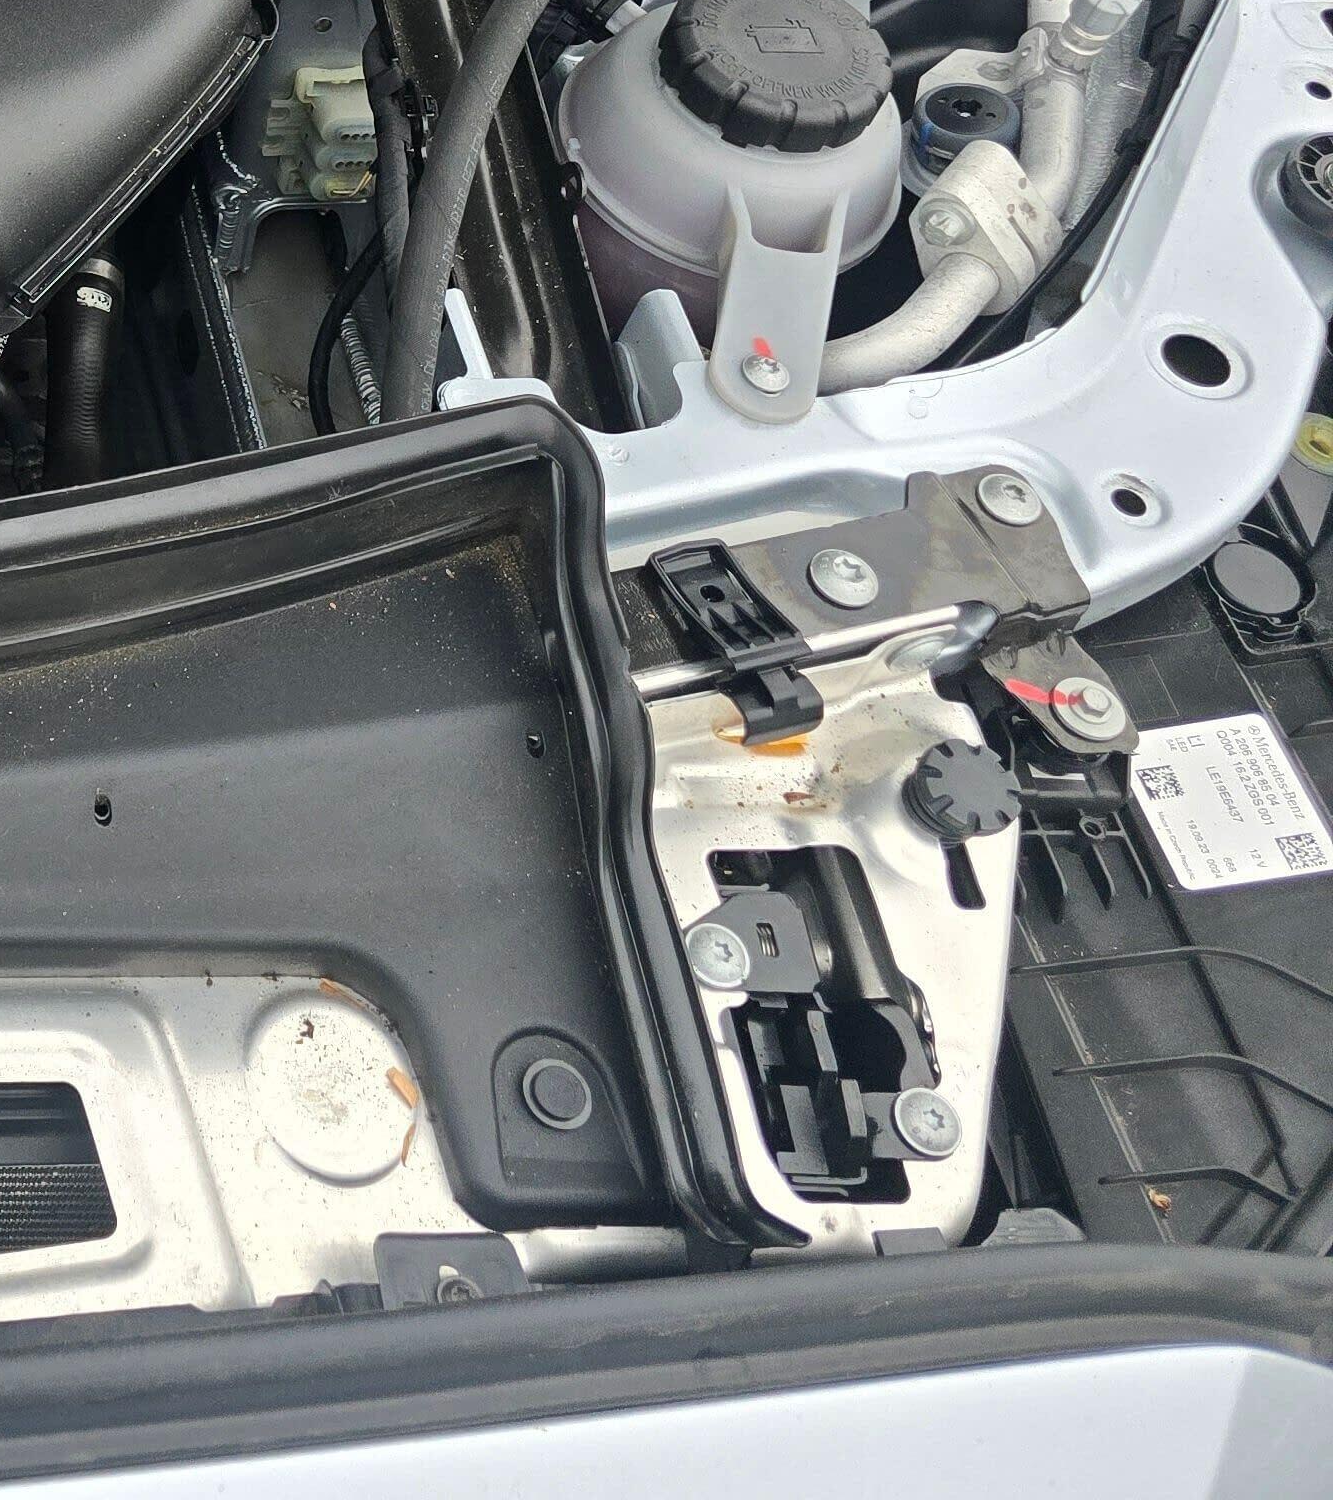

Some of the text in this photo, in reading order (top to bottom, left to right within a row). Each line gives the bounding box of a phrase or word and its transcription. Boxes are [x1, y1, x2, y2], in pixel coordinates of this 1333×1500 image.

[1175, 736, 1189, 753] LED
[1216, 730, 1237, 756] Q004
[1257, 807, 1275, 826] 001
[1229, 728, 1281, 806] A 206 906 85 04
[1252, 737, 1306, 820] Mercedes-Benz
[1249, 848, 1269, 869] 12 V
